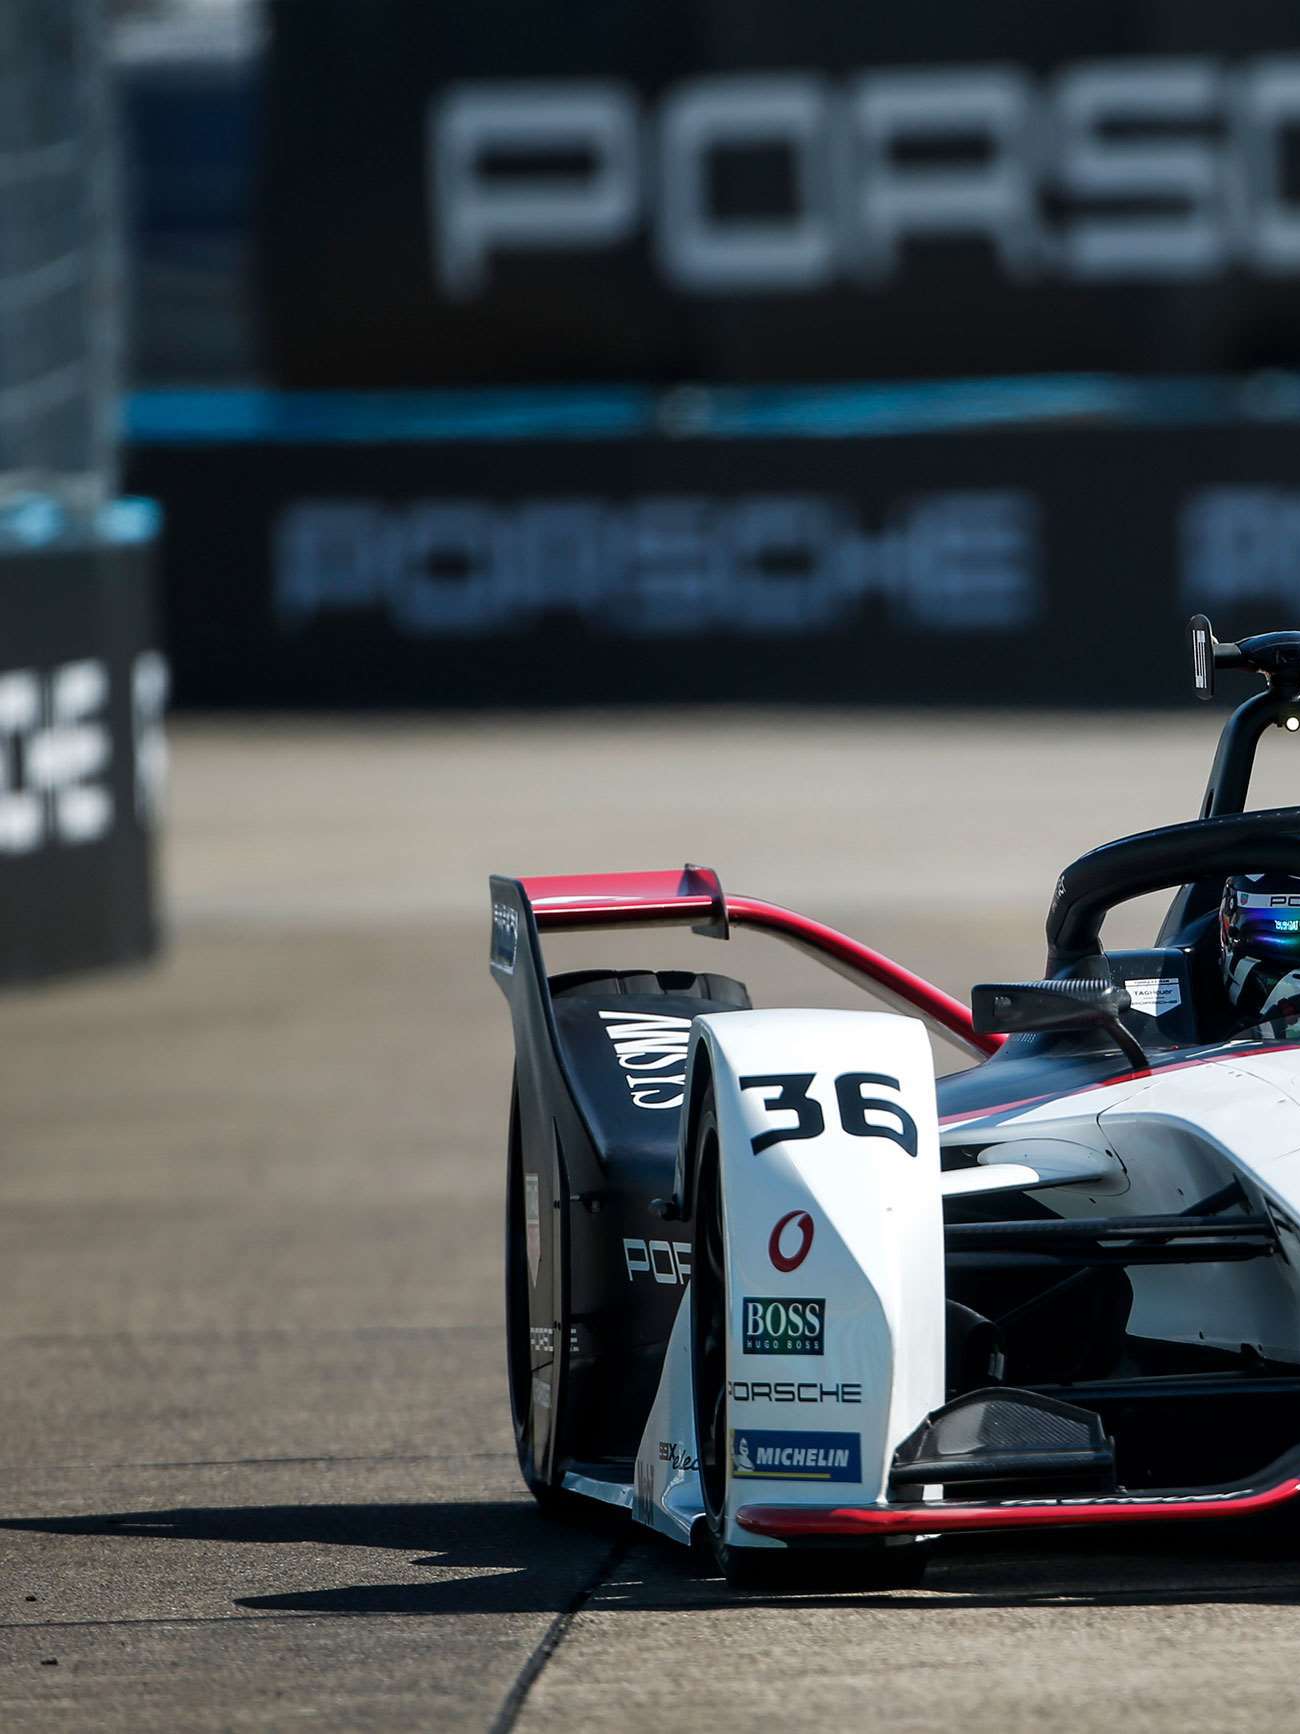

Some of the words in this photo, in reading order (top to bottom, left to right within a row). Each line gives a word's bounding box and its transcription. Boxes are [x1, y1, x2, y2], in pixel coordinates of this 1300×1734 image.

[274, 492, 1040, 634] PORSCHE
[739, 1072, 918, 1157] 36
[746, 1302, 820, 1337] BOSS
[747, 1340, 779, 1349] HUGO
[787, 1340, 819, 1349] BOSS
[728, 1381, 862, 1403] ORSCHE
[756, 1447, 849, 1467] MICHELIN
